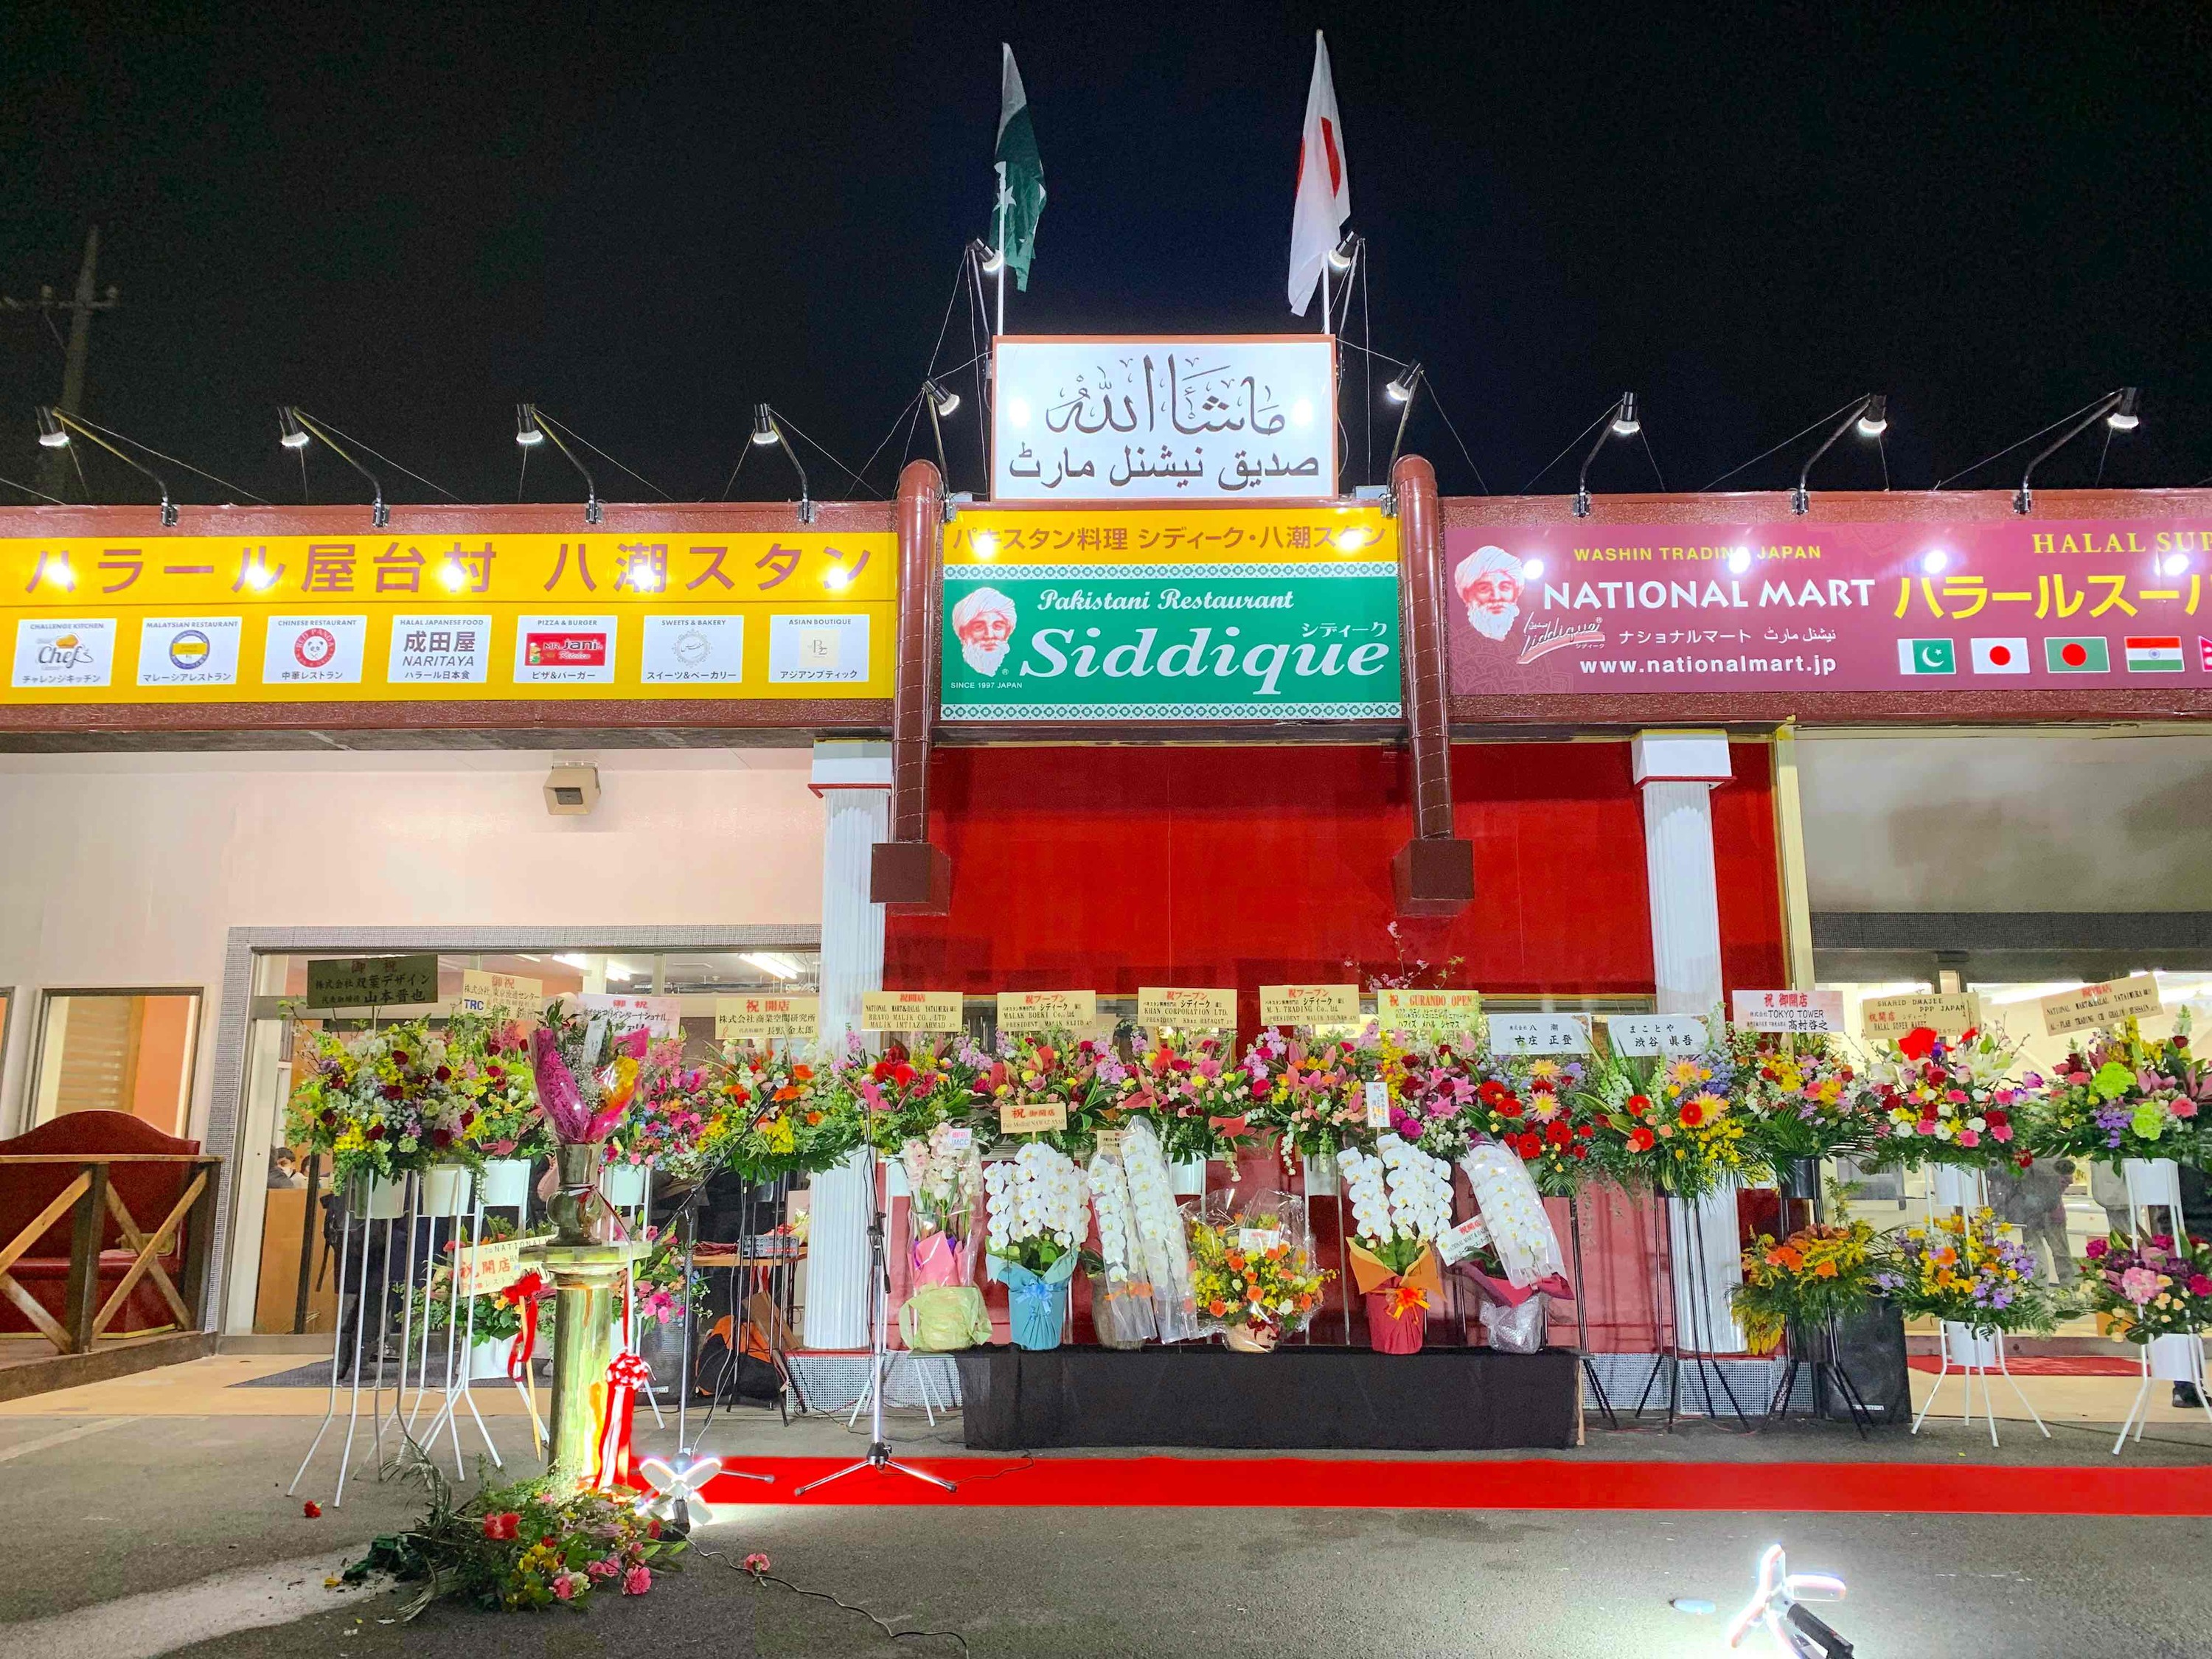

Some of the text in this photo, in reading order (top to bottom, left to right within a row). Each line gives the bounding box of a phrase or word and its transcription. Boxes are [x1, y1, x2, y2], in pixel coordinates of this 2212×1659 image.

[2032, 532, 2146, 554] HALAL
[1574, 546, 1820, 562] WASHIN TRADIN JAPAN
[25, 541, 872, 594] ハラール屋台村 八潮スタン
[1037, 588, 1295, 611] Pakistani Restaurant
[1544, 579, 1876, 611] NATIONAL MART
[1301, 622, 1388, 639] シディーク
[1618, 630, 1751, 645] ナショナルマート
[403, 630, 476, 653] 成田屋
[402, 655, 474, 667] NARITAYA
[1019, 625, 1391, 696] Siddique
[1579, 655, 1837, 677] www.nationalmart.jp
[22, 674, 101, 684] チャレンジキッチン
[143, 672, 232, 682] マレーシアレストラン
[282, 671, 343, 680] 中華レストラン
[405, 670, 470, 680] ハラール日本食
[780, 669, 858, 679] アジアンブティック
[464, 998, 484, 1011] TRC
[1409, 994, 1446, 1006] GURANDO
[1768, 1009, 1795, 1018] TOKYO
[1797, 1009, 1825, 1018] TOWER
[1630, 1023, 1674, 1034] まことや
